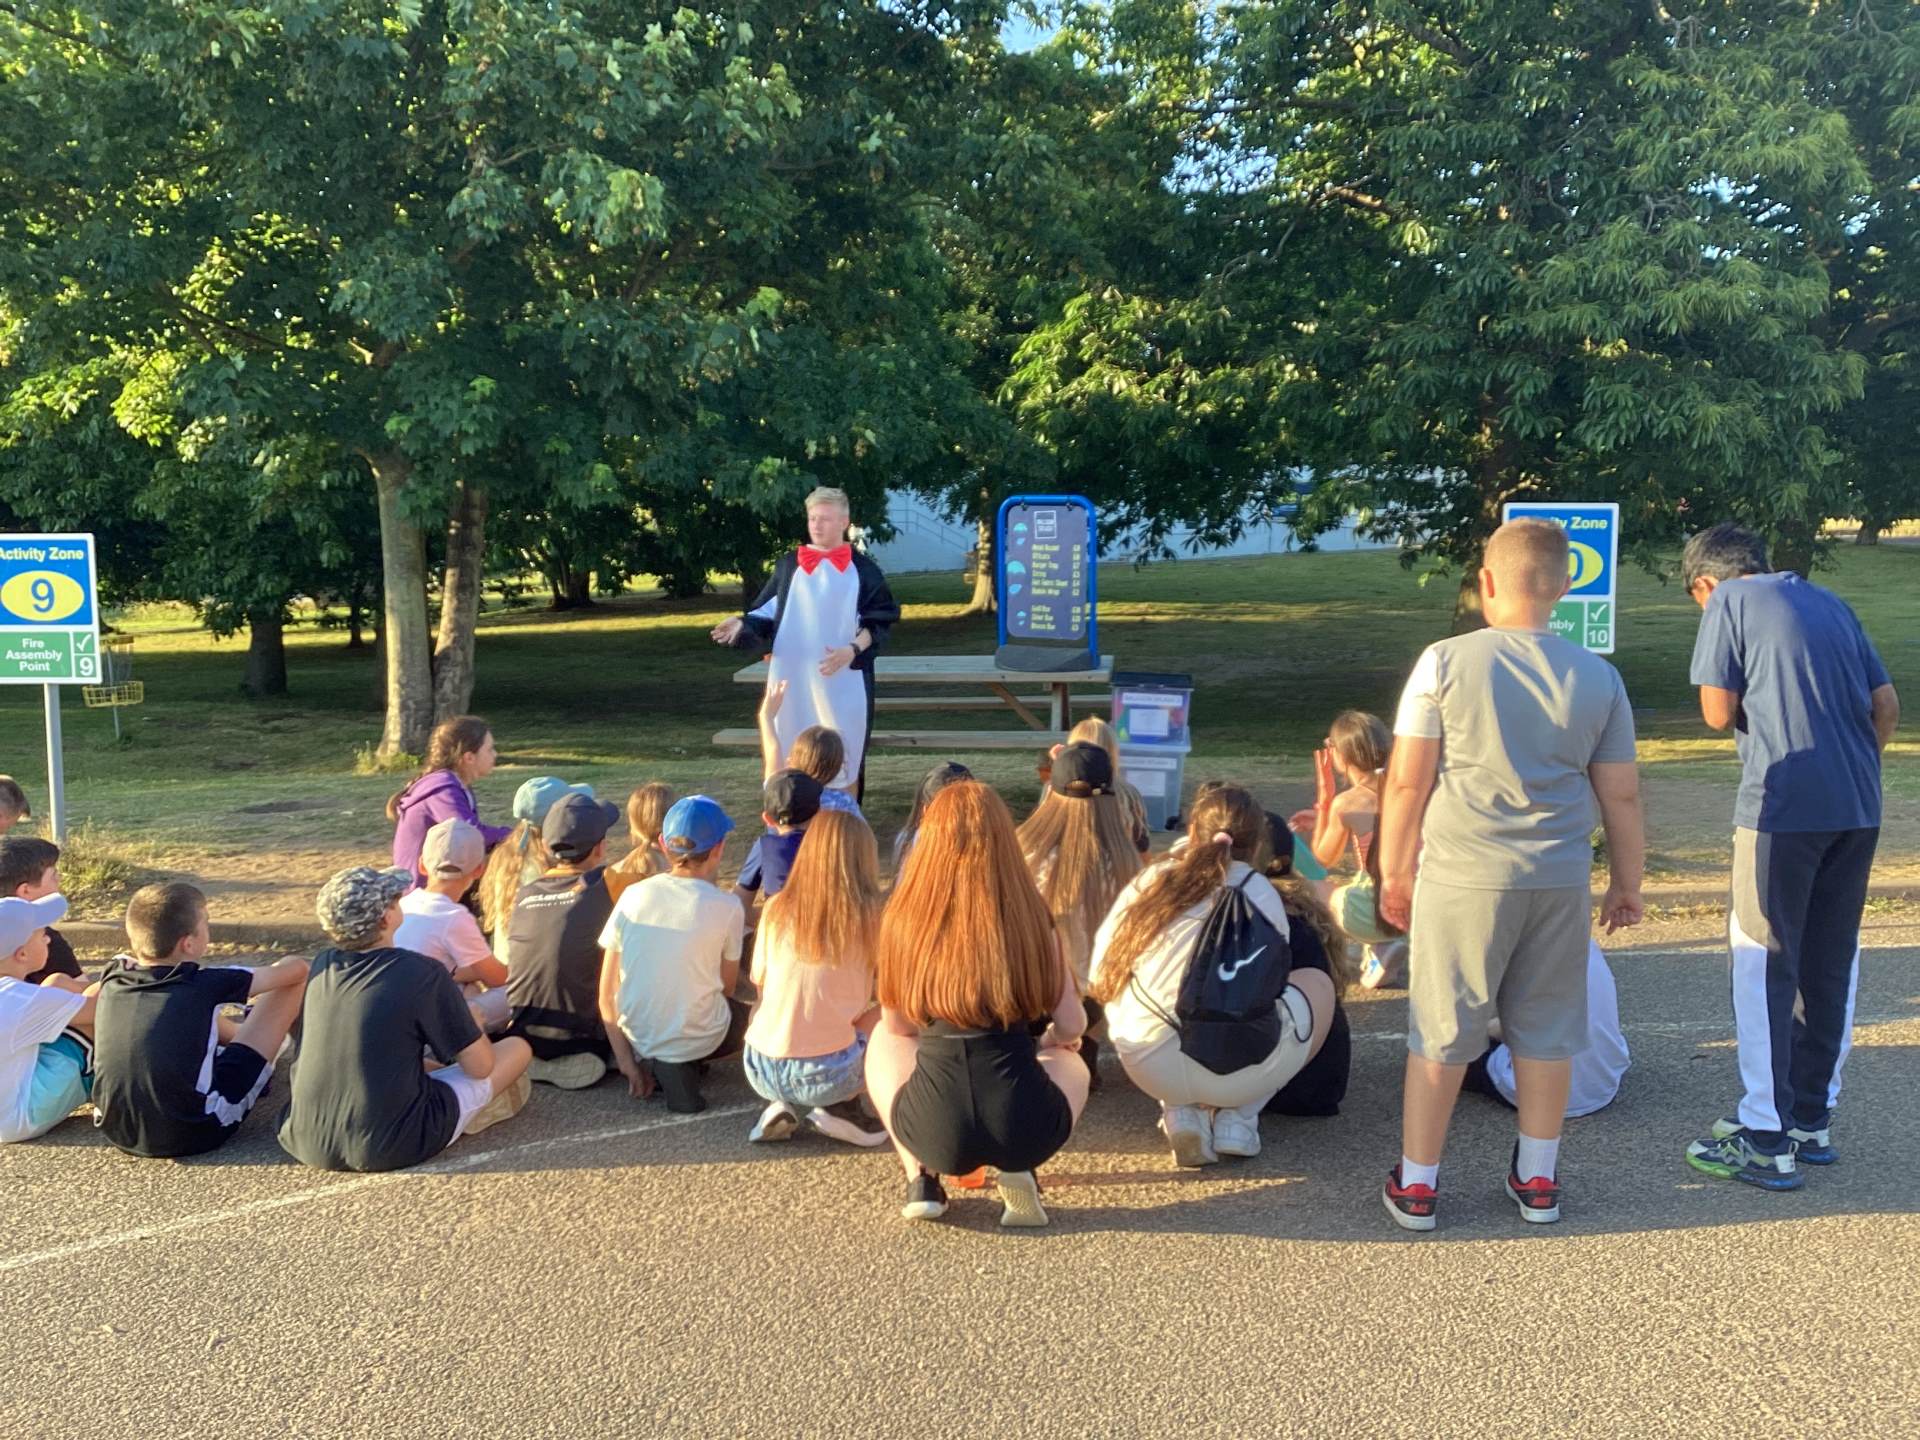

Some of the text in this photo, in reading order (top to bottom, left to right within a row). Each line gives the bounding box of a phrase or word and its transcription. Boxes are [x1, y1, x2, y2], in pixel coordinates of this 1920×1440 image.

[1570, 516, 1608, 529] Zone
[0, 547, 84, 563] Activity Zone
[31, 578, 55, 613] 9
[22, 638, 44, 648] Fire
[1589, 630, 1608, 644] 10
[6, 650, 62, 661] Assembly
[19, 661, 50, 671] Point
[79, 657, 93, 676] 9
